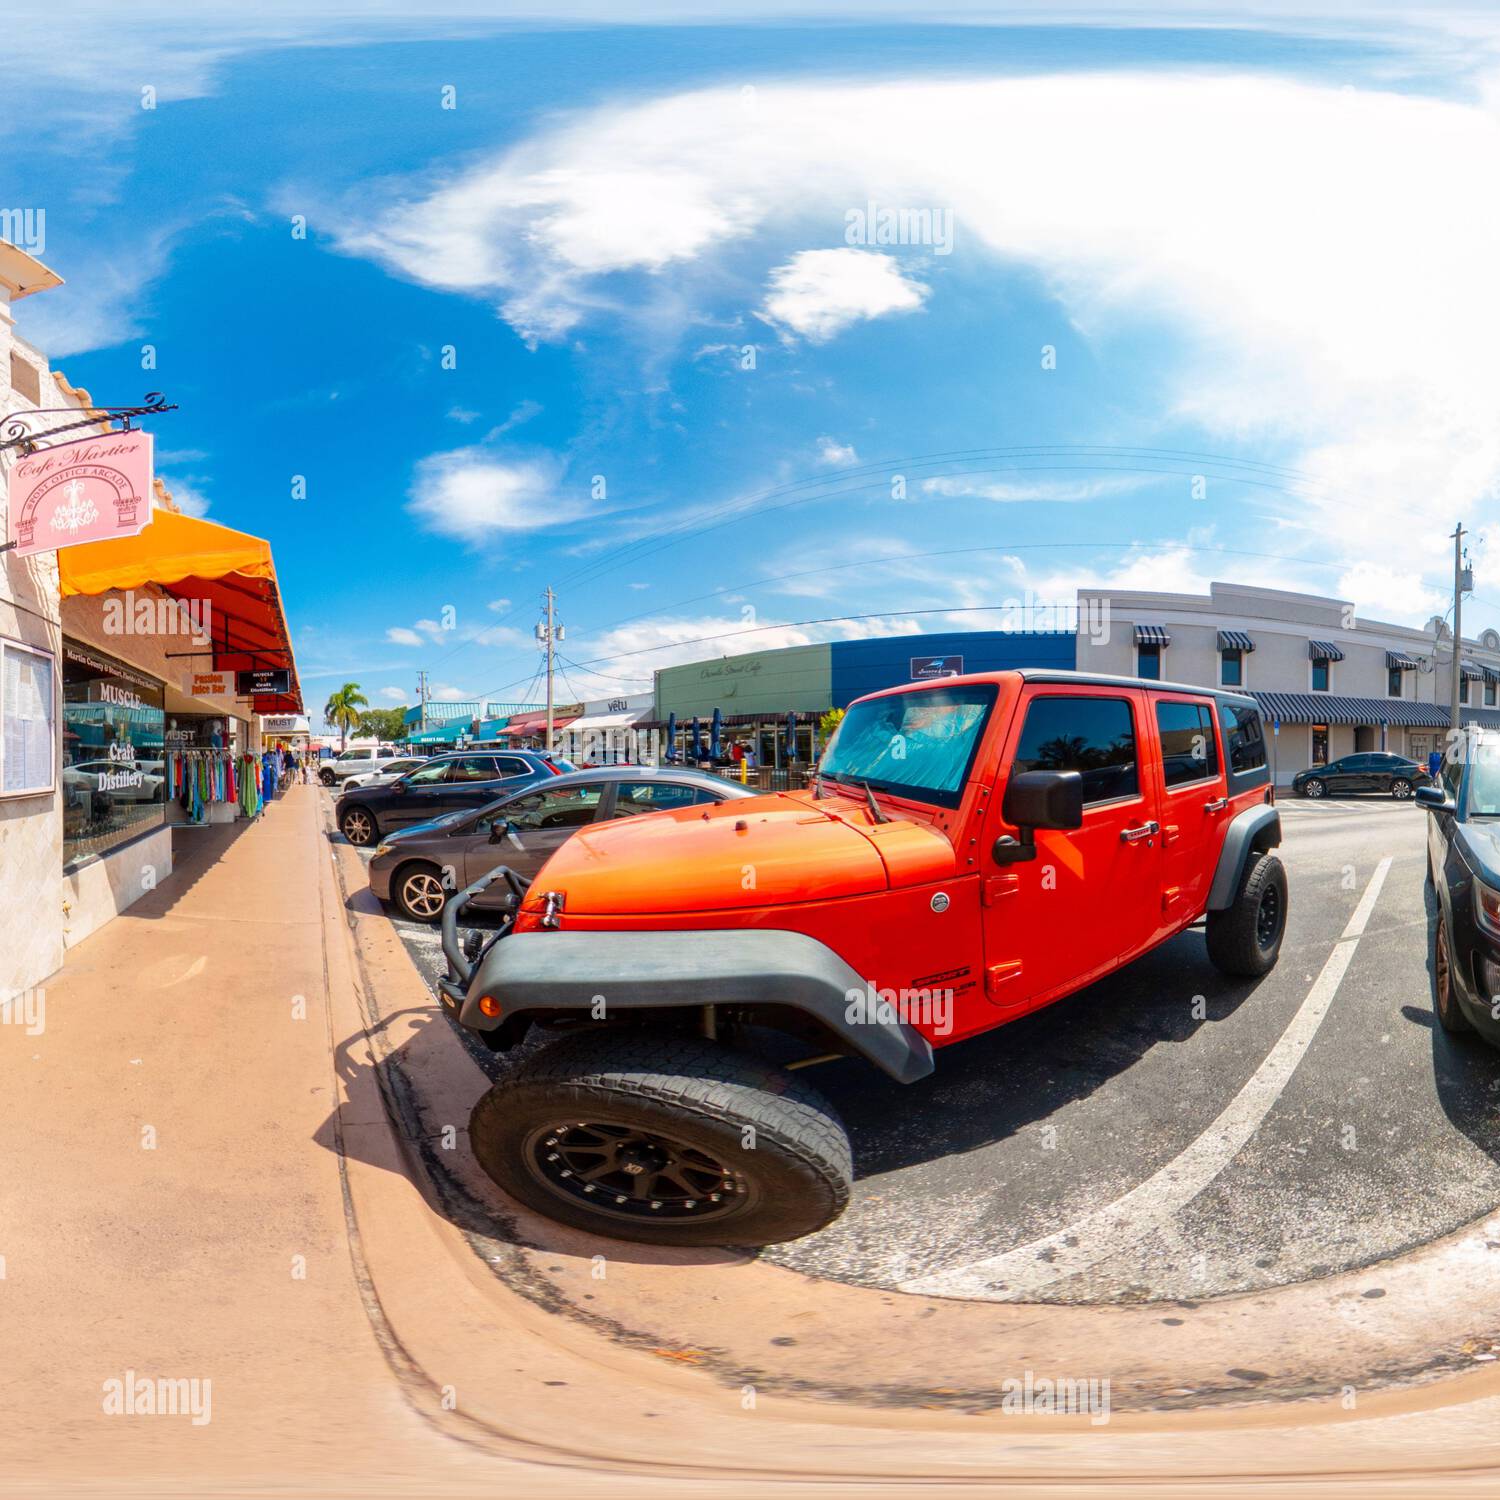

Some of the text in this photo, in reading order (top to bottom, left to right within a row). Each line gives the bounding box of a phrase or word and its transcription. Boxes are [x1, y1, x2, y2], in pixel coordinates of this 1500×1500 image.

[58, 445, 140, 466] Martier
[52, 468, 88, 484] OFFICE
[91, 468, 128, 490] ARCADE
[194, 673, 224, 684] Passion
[100, 682, 142, 709] MUSCLE
[212, 684, 226, 695] Bar
[268, 718, 292, 727] MUST
[110, 742, 135, 762] Craft
[98, 770, 144, 792] Distillery
